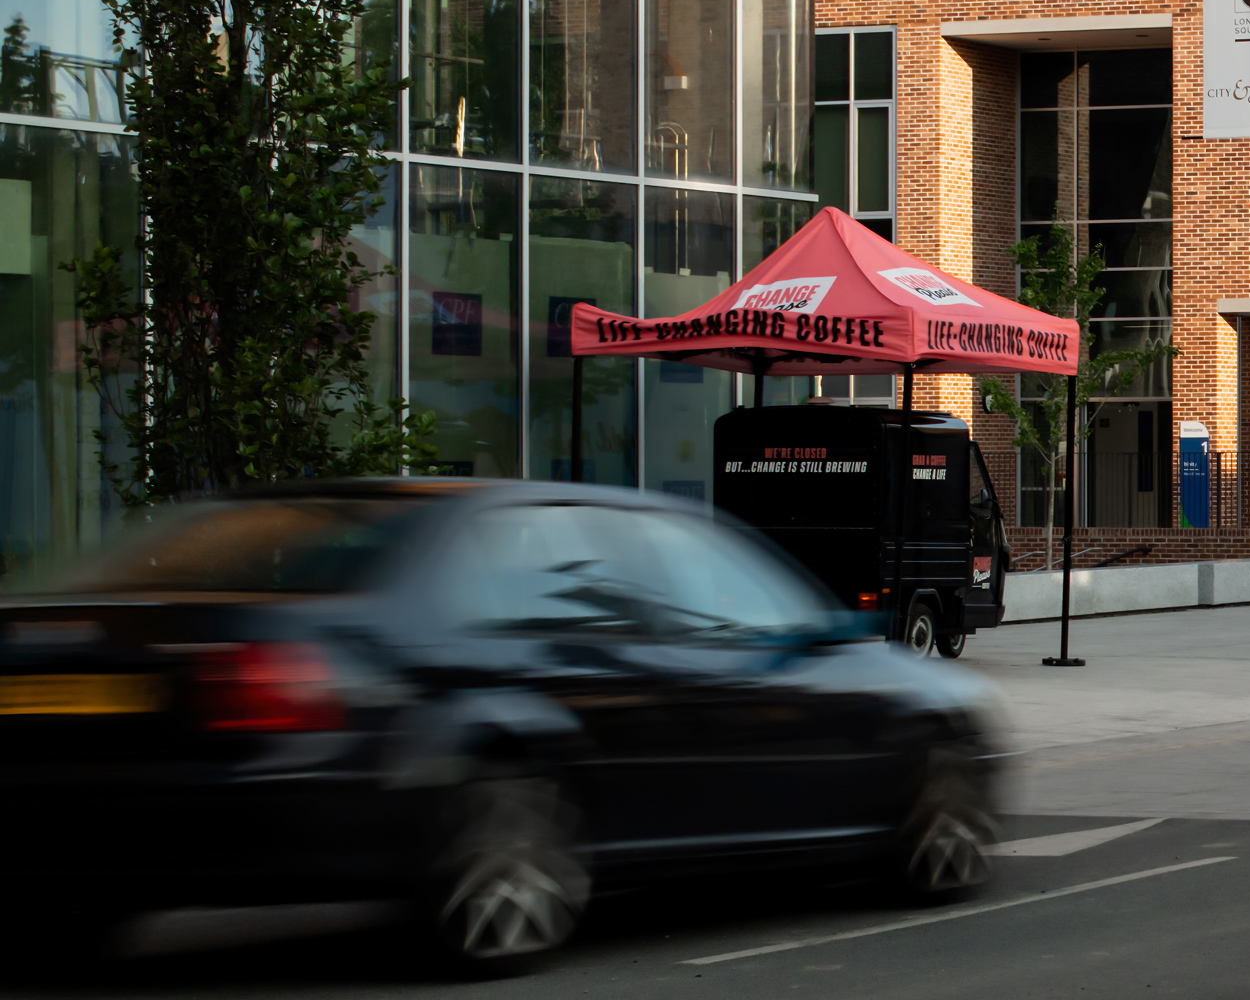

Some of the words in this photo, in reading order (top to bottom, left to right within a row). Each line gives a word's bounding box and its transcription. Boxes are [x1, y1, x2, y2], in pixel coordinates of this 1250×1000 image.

[1207, 88, 1231, 99] CITY
[744, 284, 821, 308] CHANGE
[796, 313, 885, 348] COFFEE
[927, 320, 1024, 357] LIFE-CHANGING
[1027, 329, 1069, 362] COFFEE
[794, 447, 827, 459] CLOSED
[1201, 441, 1208, 456] 1
[788, 461, 798, 473] IS
[799, 461, 823, 473] STILL
[825, 461, 868, 473] BREWING
[936, 468, 947, 480] LIFE
